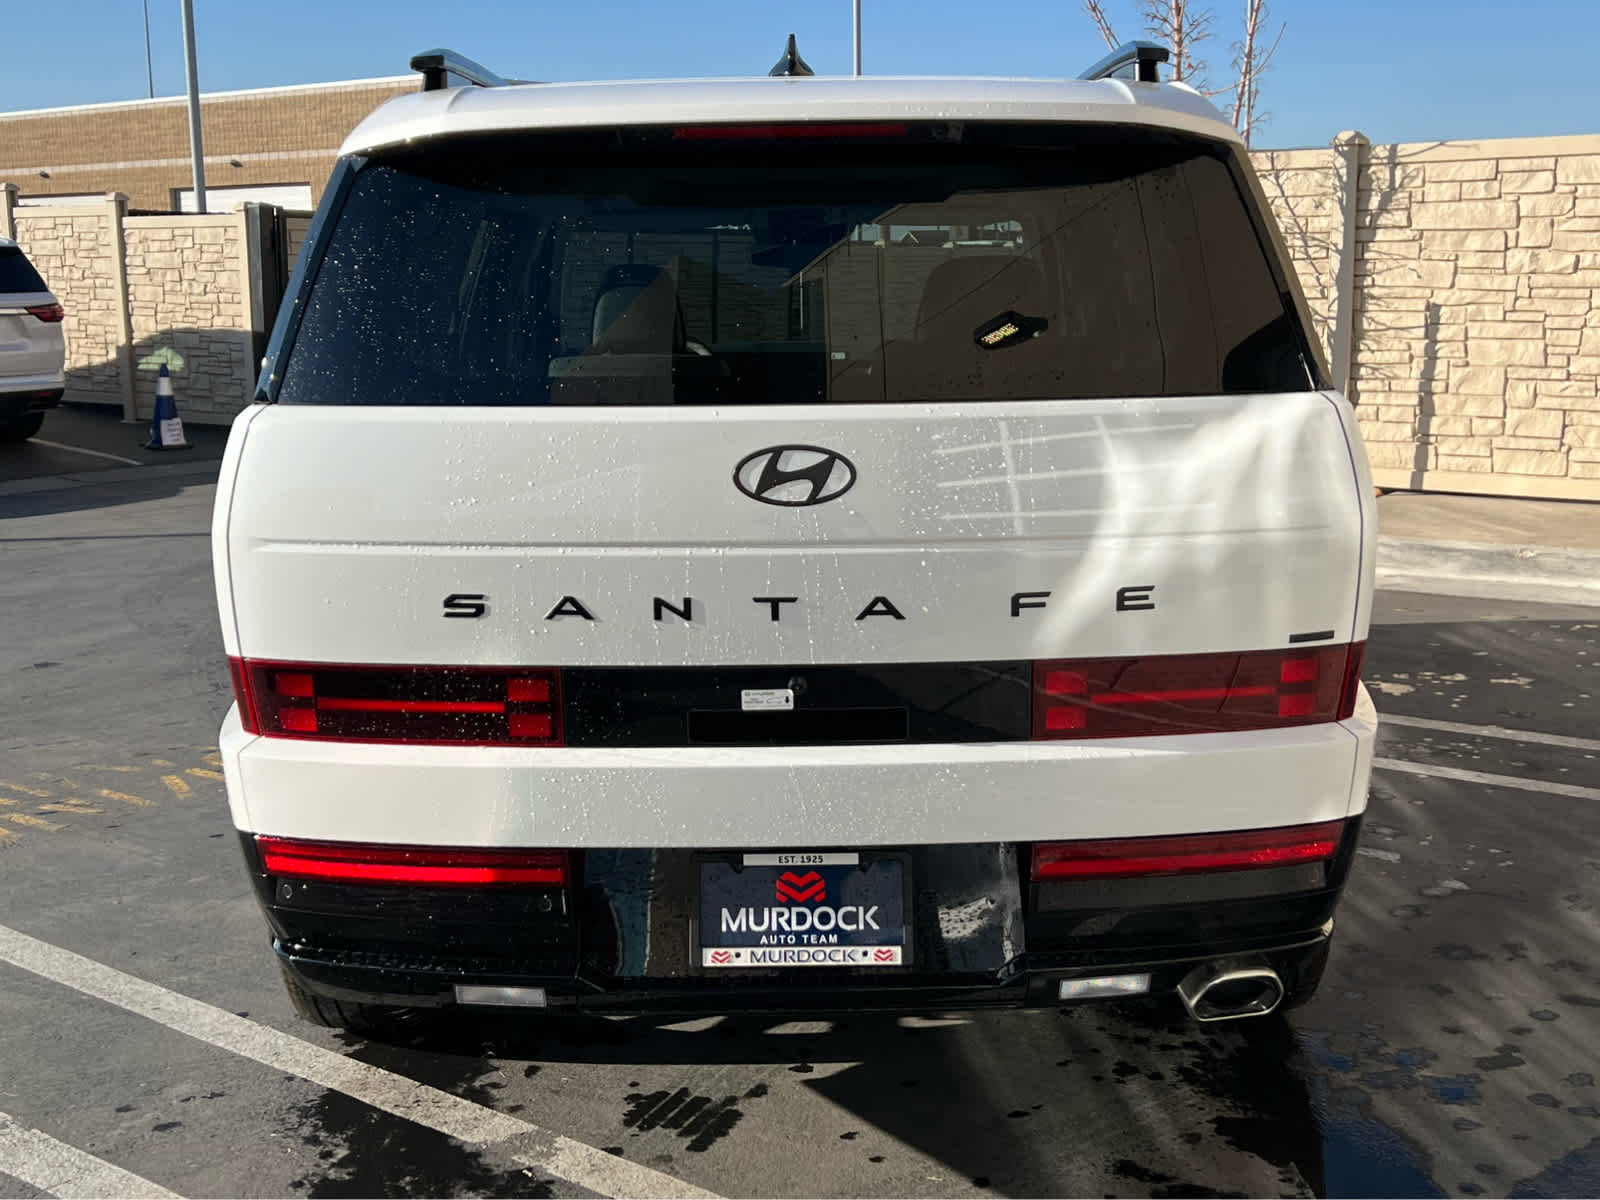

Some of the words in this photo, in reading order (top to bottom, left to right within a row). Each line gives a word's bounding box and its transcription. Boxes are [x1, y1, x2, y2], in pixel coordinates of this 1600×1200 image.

[443, 593, 907, 622] SANTA
[1010, 585, 1156, 617] FE
[800, 855, 824, 864] 1925
[721, 905, 880, 933] MURDOCK
[760, 934, 796, 945] AUTO
[802, 934, 838, 944] TEAM
[749, 949, 857, 964] MURDOCK
